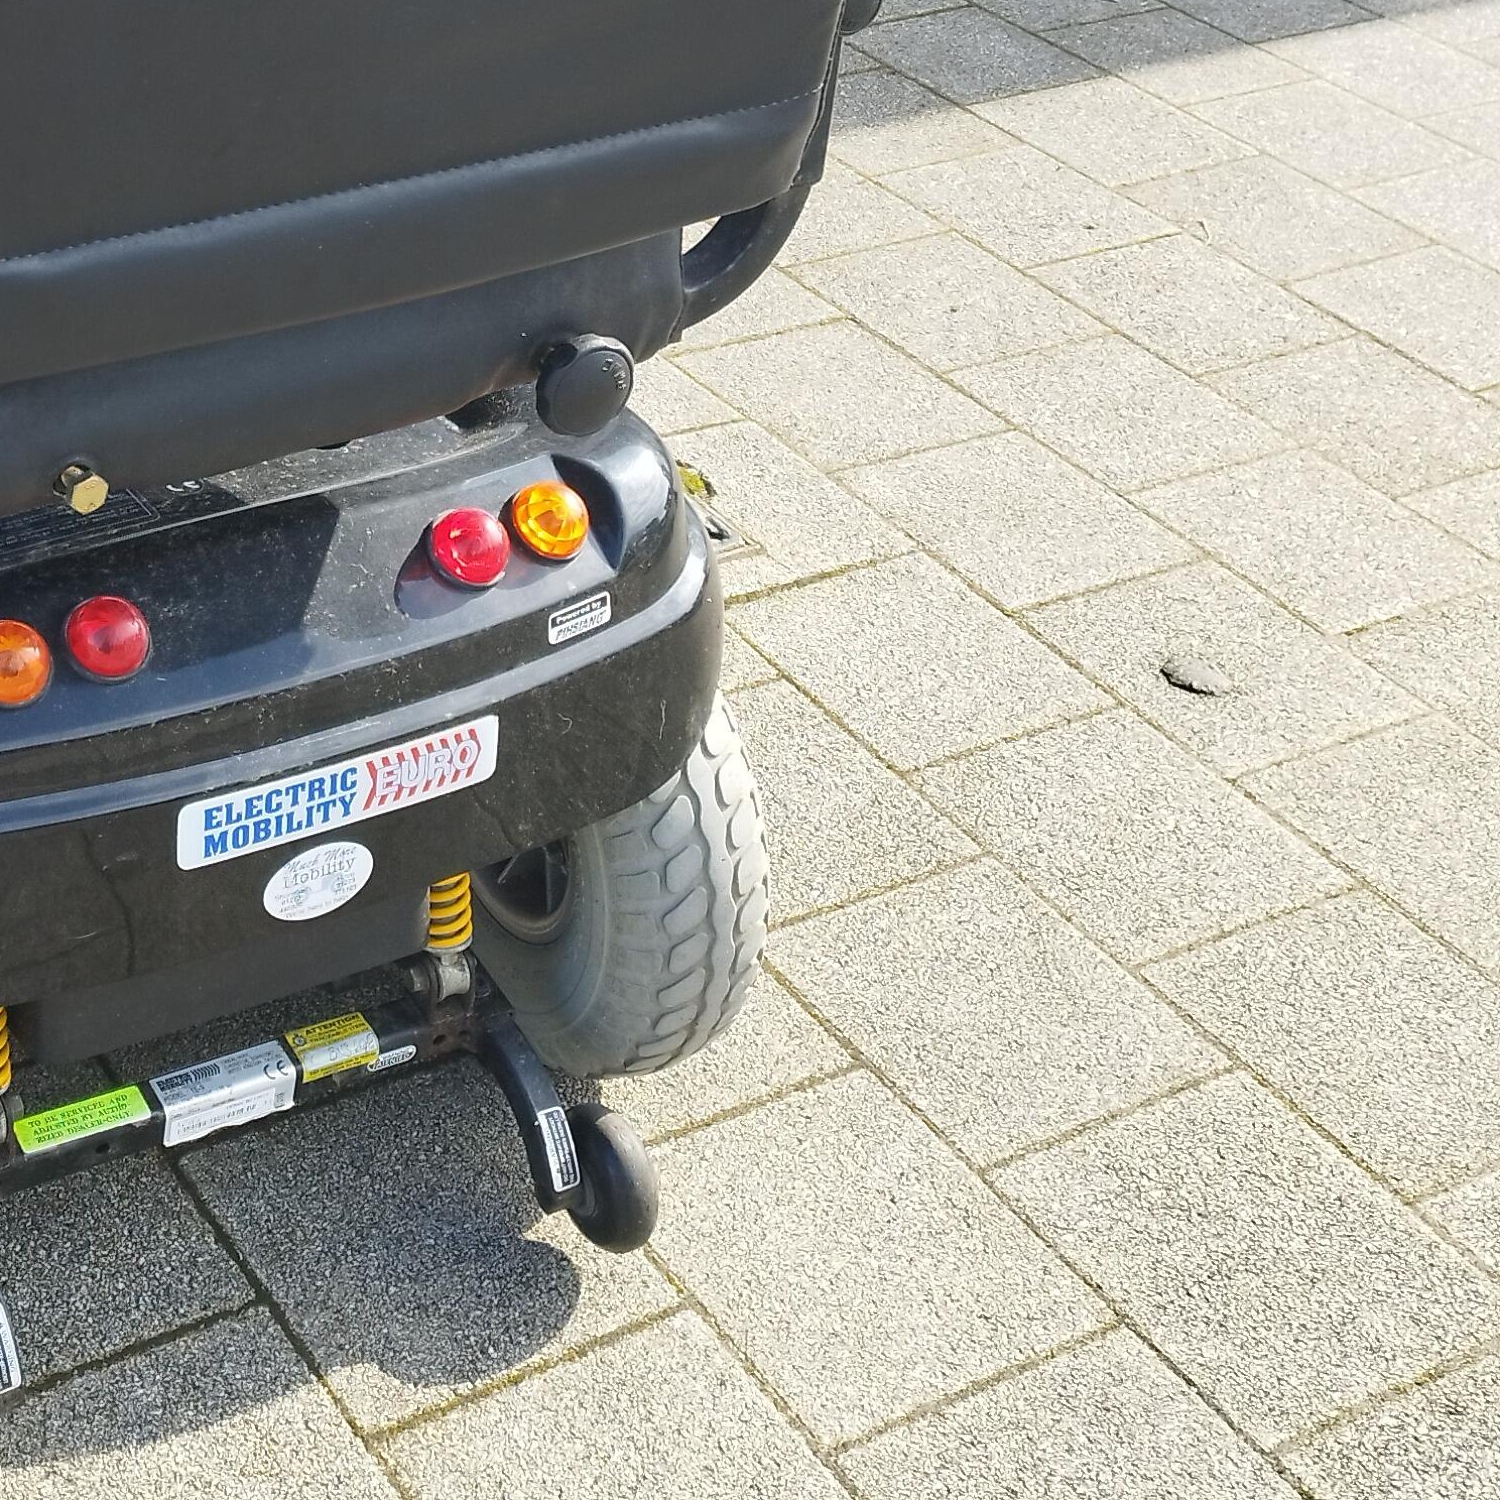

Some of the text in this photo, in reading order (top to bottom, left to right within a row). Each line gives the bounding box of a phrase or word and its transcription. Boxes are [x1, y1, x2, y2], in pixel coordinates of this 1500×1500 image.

[204, 738, 480, 831] ELECTRIC EURO
[203, 792, 358, 859] MOBILITY
[284, 857, 357, 889] Mobility
[305, 1014, 360, 1036] ATTENTION
[28, 1120, 42, 1129] TO
